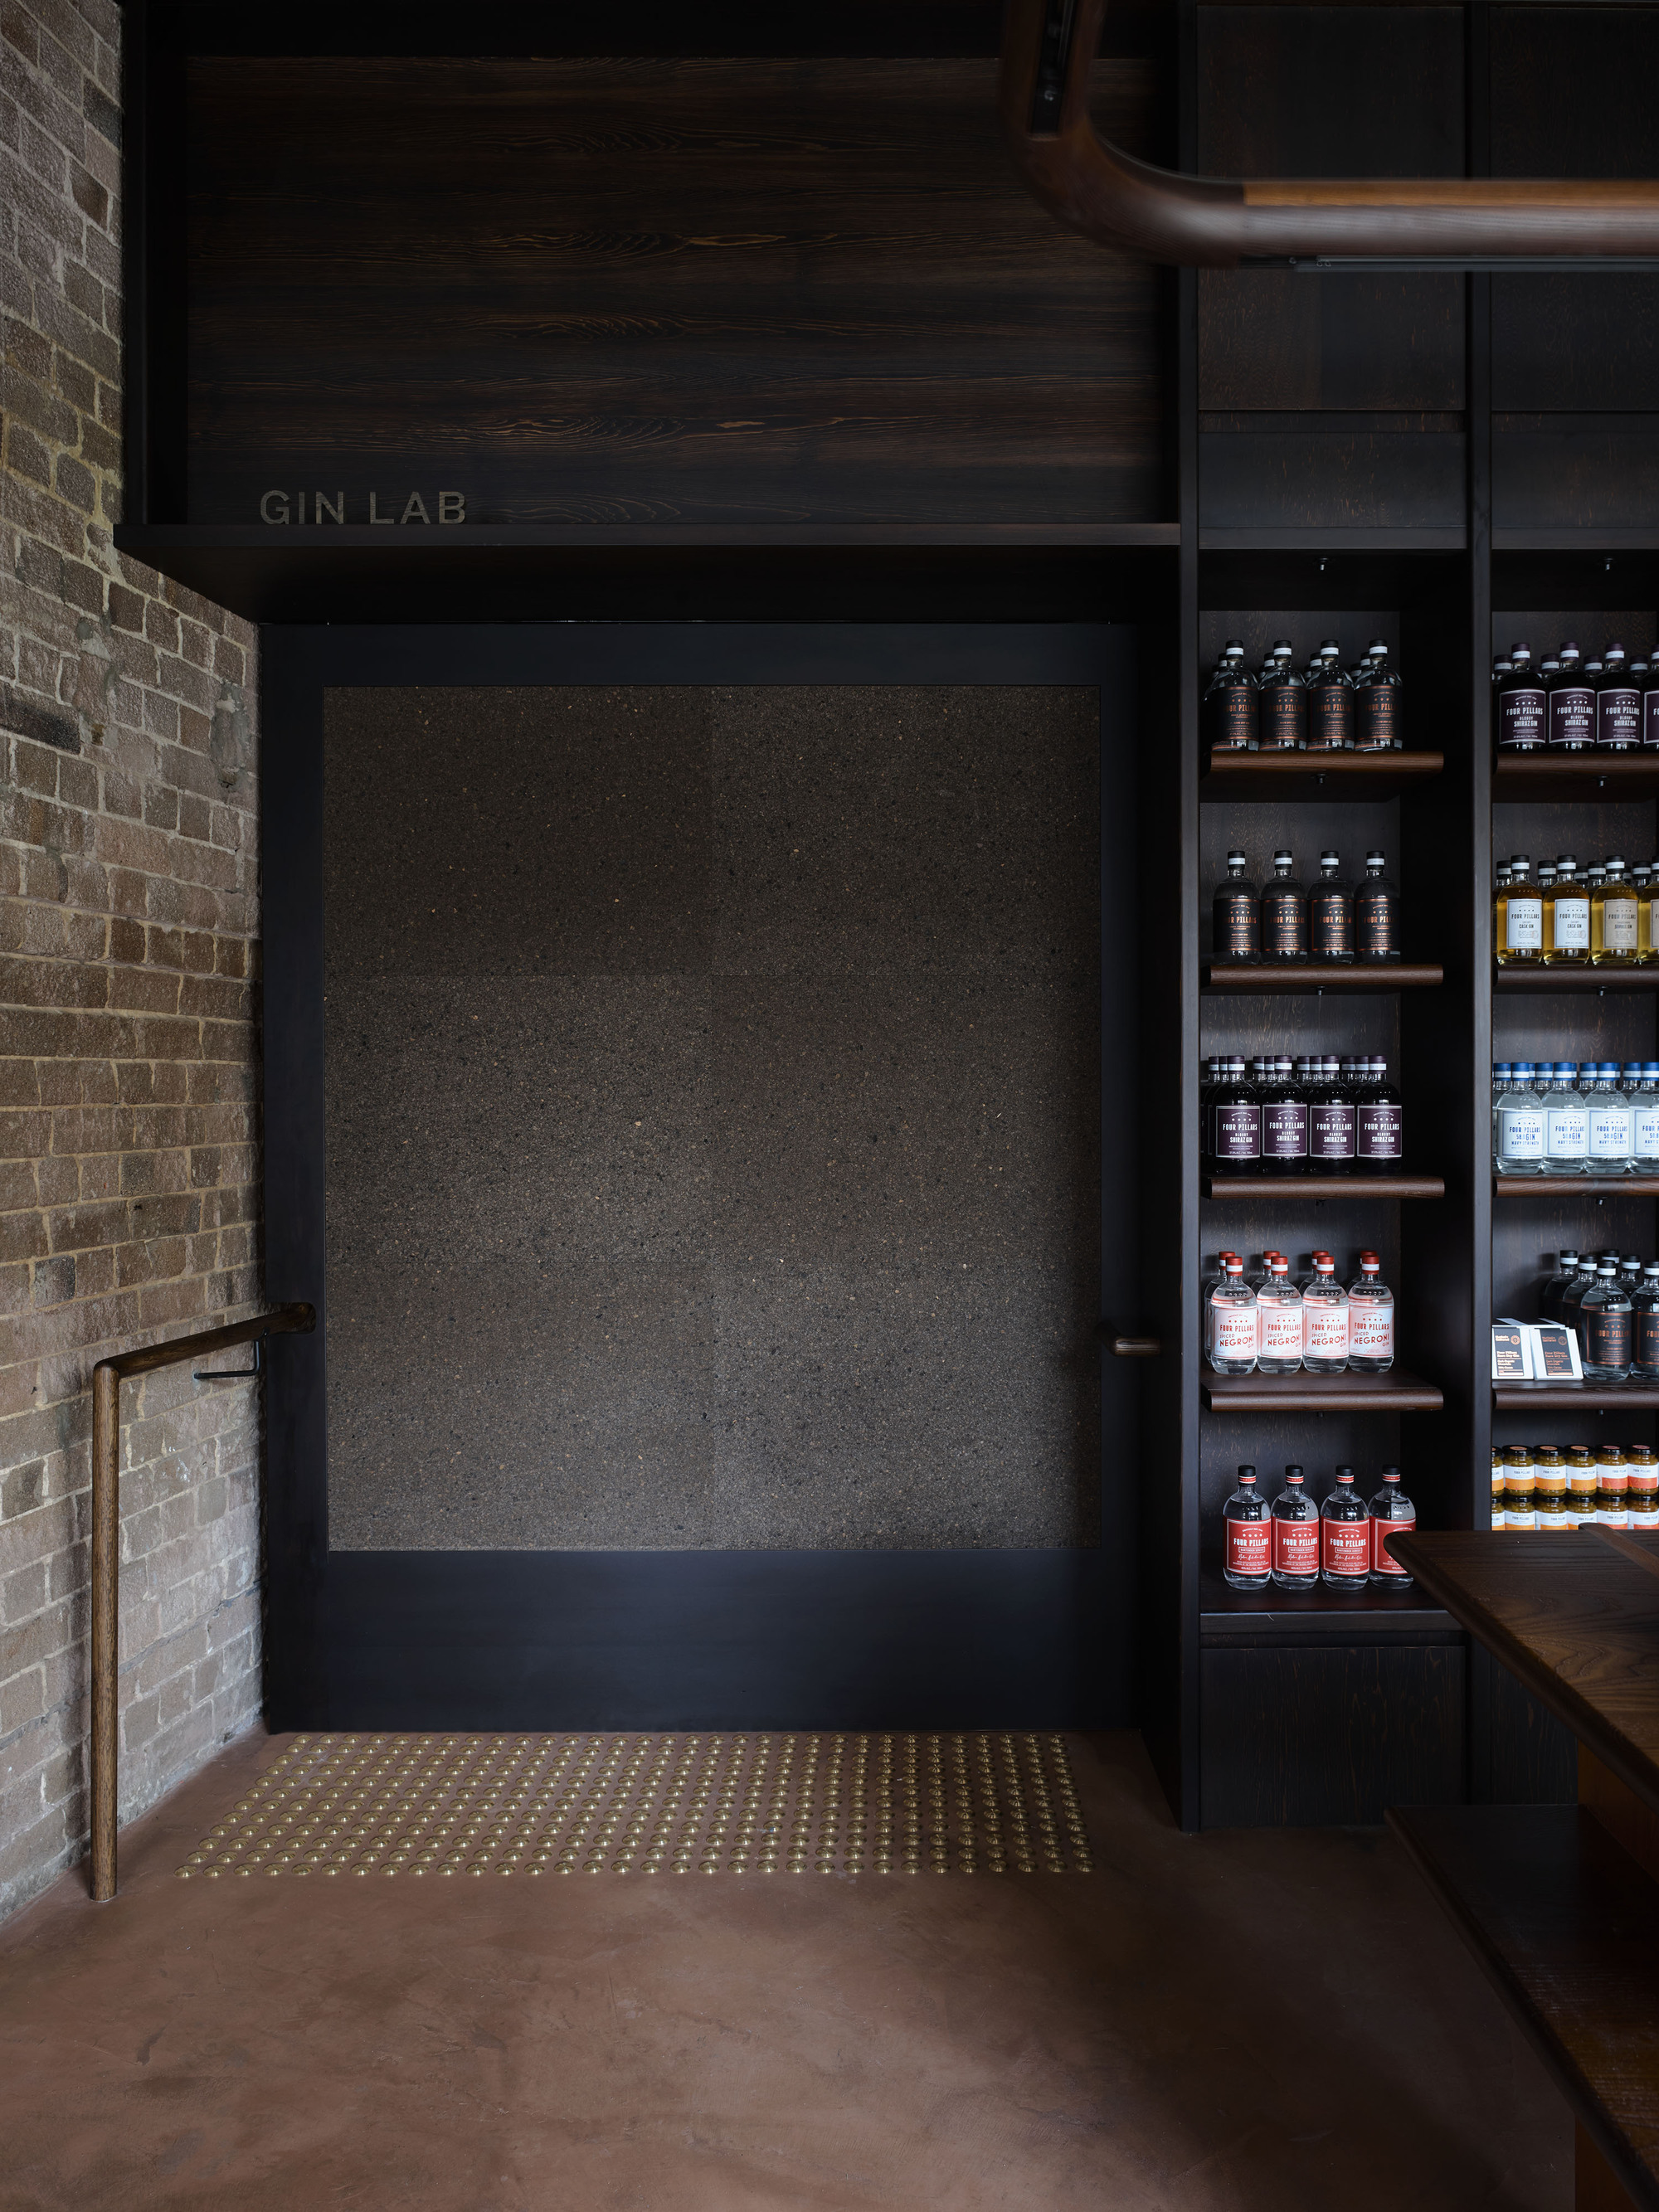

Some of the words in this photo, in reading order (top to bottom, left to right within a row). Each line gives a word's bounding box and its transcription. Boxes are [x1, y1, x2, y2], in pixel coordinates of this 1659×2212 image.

[260, 490, 344, 524] GIN
[370, 491, 465, 524] LAB
[1623, 707, 1639, 715] PILLARS
[1220, 1335, 1254, 1347] NEGRONI
[1268, 1334, 1301, 1346] NEGRONI
[1312, 1334, 1346, 1346] NEGRONI
[1354, 1334, 1389, 1344] NEGRONI
[1249, 1538, 1268, 1546] PILLARS
[1299, 1537, 1317, 1546] PILLARS
[1346, 1539, 1366, 1547] PILLARS
